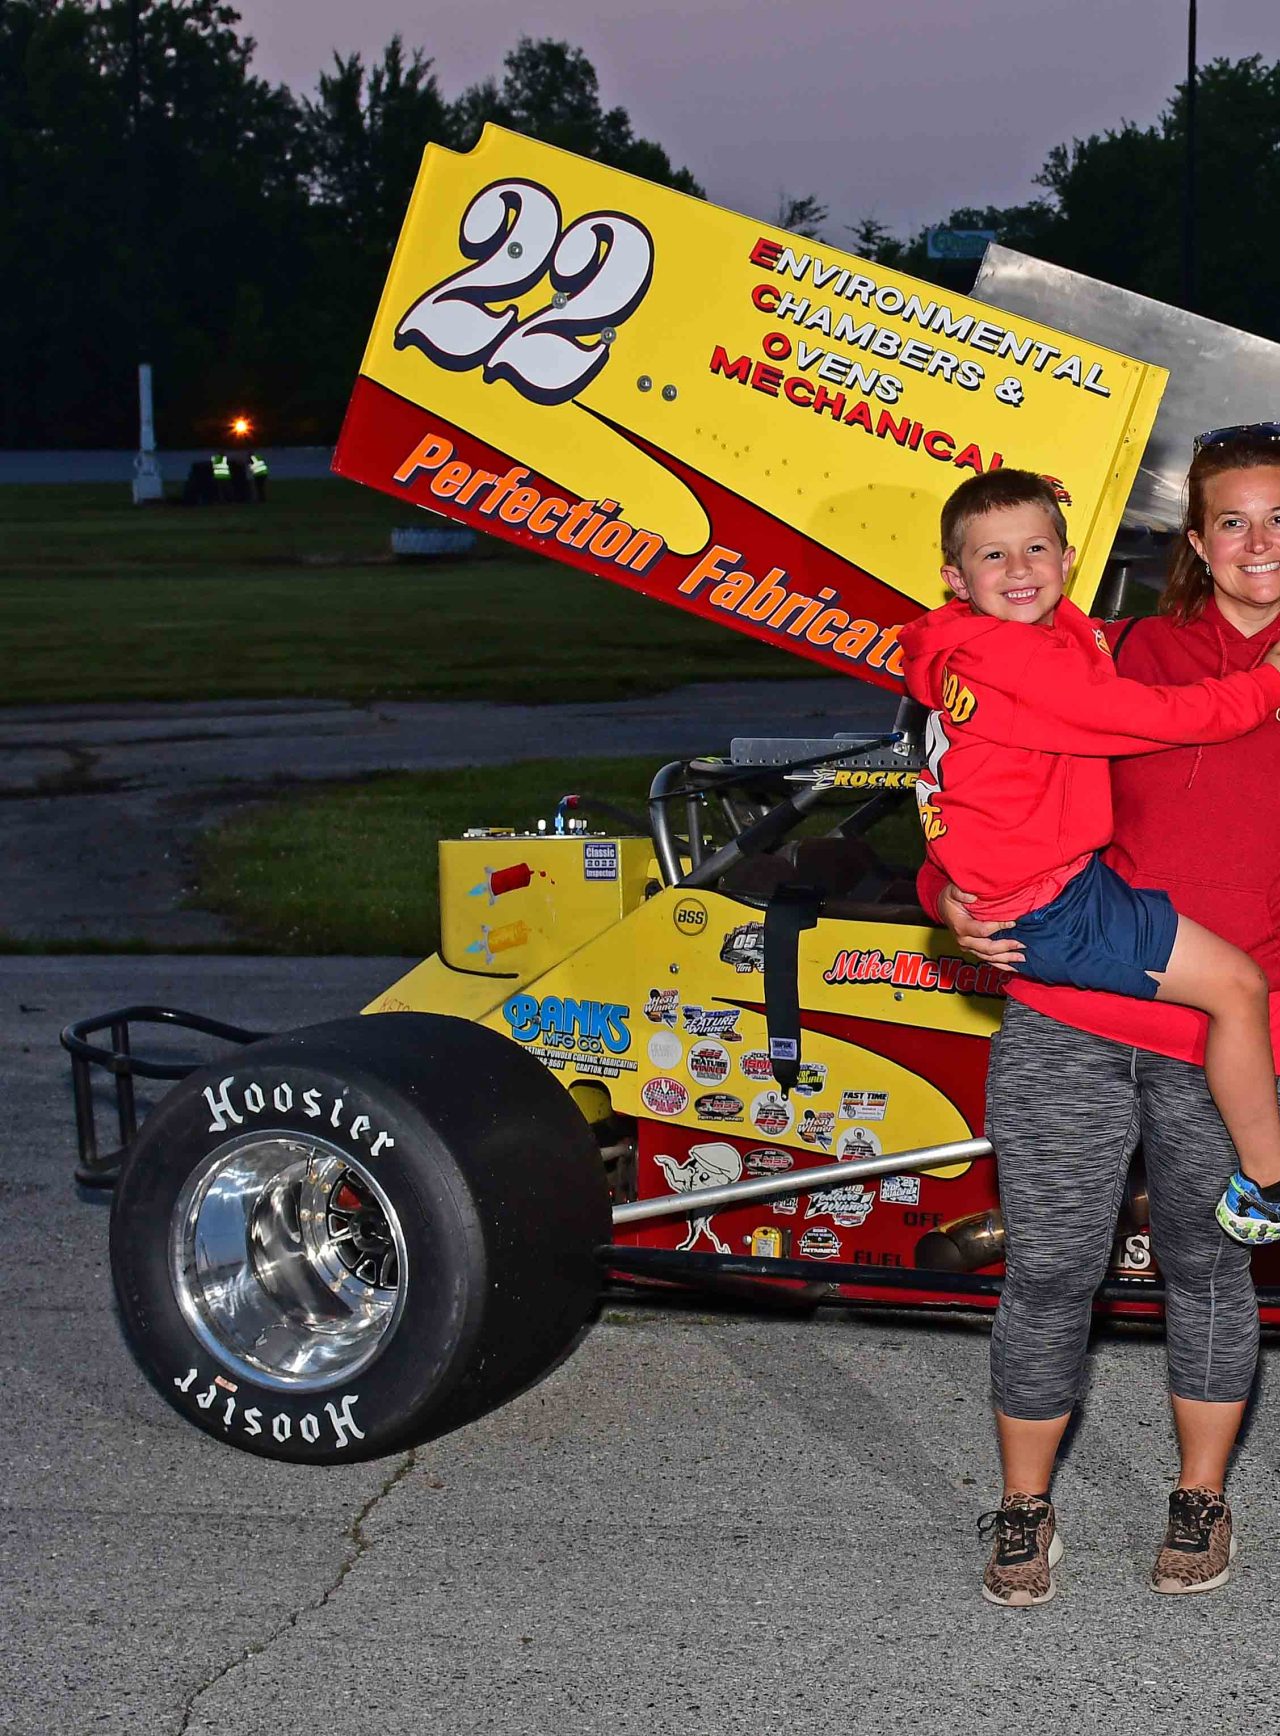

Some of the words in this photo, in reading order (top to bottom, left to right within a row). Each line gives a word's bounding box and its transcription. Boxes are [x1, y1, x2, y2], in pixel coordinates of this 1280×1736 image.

[394, 177, 655, 406] 22
[748, 237, 1112, 397] ENVIRONMENTAL
[751, 283, 986, 389] CHAMBERS
[993, 375, 1025, 407] &
[762, 331, 905, 405] OVENS
[394, 433, 668, 574] Perfection
[586, 847, 615, 858] Classic
[586, 869, 616, 878] Inspected
[677, 909, 705, 925] BSS
[733, 934, 758, 949] 05
[825, 950, 894, 982] Mike
[644, 1003, 679, 1013] Winner
[650, 996, 678, 1005] Heat
[502, 993, 630, 1055] BANKS
[683, 1016, 736, 1028] FEATURE
[685, 1025, 731, 1035] Winner
[543, 1032, 575, 1048] MFG
[577, 1036, 605, 1054] CO.
[546, 1049, 573, 1062] POWDER
[599, 1056, 638, 1071] FABRICATING
[691, 1057, 728, 1068] FEATURE
[603, 1067, 620, 1078] OHIO
[691, 1064, 727, 1075] WINNER
[843, 1091, 865, 1099] FAST
[201, 1075, 396, 1158] Hoosier
[804, 1117, 831, 1126] Heat
[797, 1124, 835, 1134] Winner
[809, 1190, 860, 1203] Feature
[815, 1201, 870, 1213] Winner
[903, 1212, 943, 1227] OFF
[852, 1250, 904, 1267] FUEL
[174, 1367, 366, 1449] Hoosier
